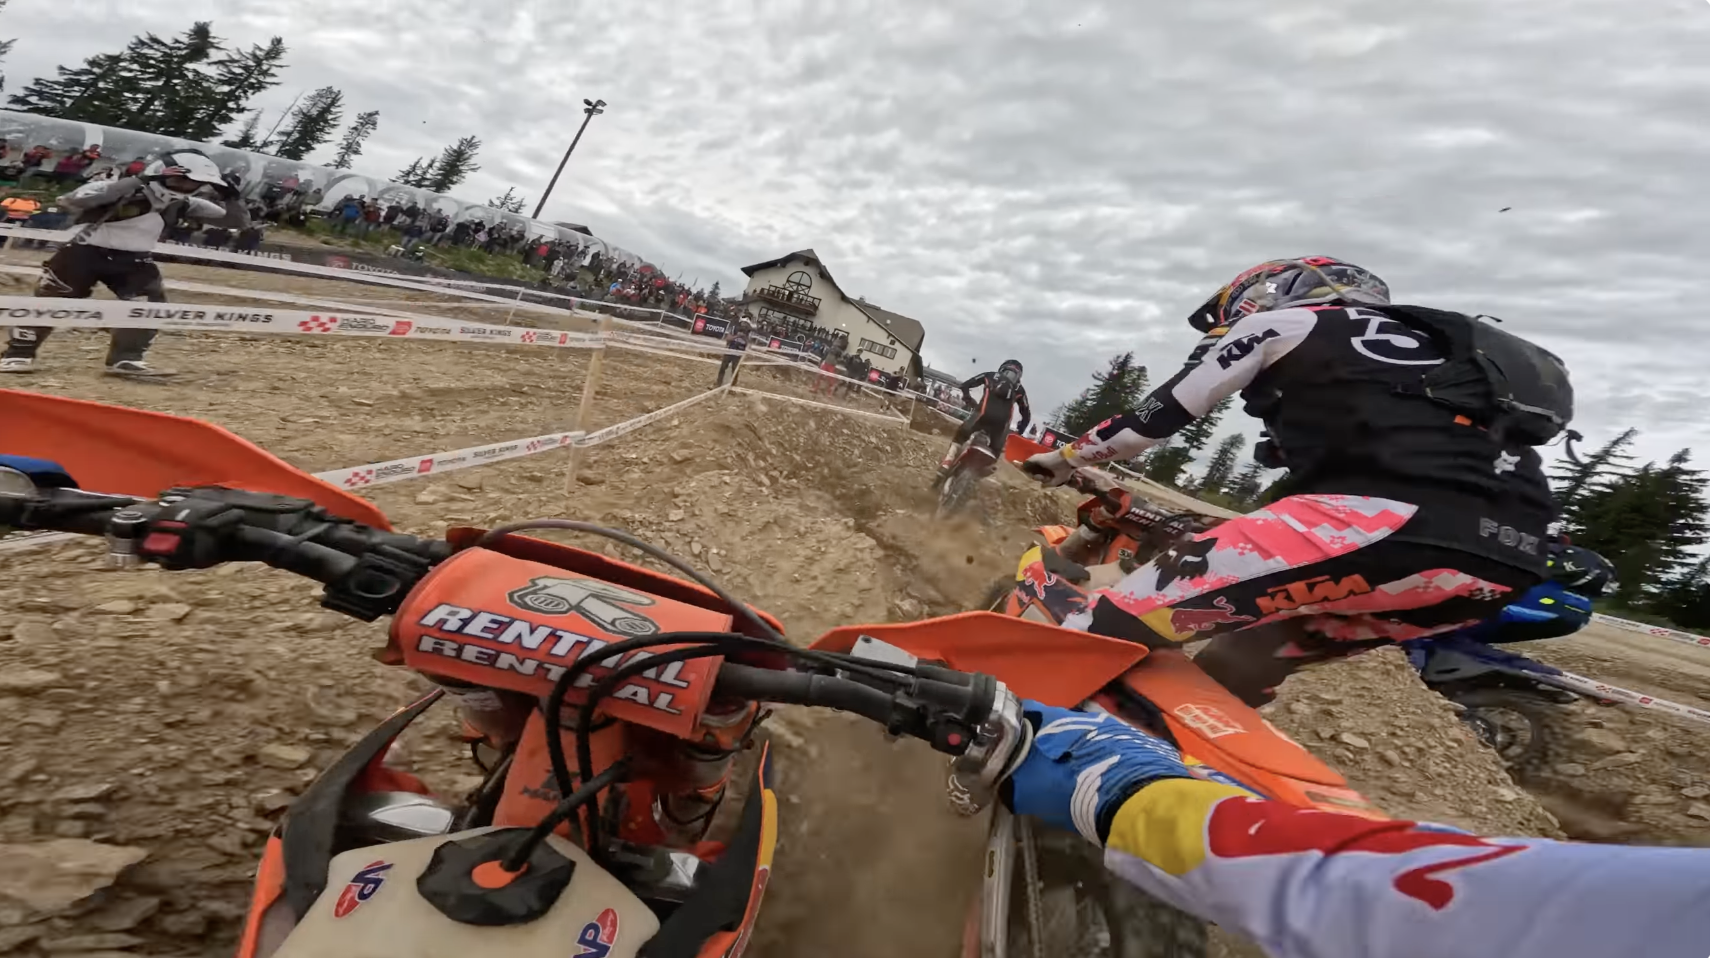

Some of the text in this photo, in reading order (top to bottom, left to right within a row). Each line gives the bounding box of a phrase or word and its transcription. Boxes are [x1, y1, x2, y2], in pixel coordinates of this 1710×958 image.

[127, 308, 207, 321] SILVER
[213, 311, 274, 324] KINGS
[705, 323, 726, 334] TOYOTA
[1216, 327, 1282, 371] KTM
[1479, 516, 1541, 556] FOX
[1255, 573, 1371, 614] KTM
[350, 862, 394, 902] VP
